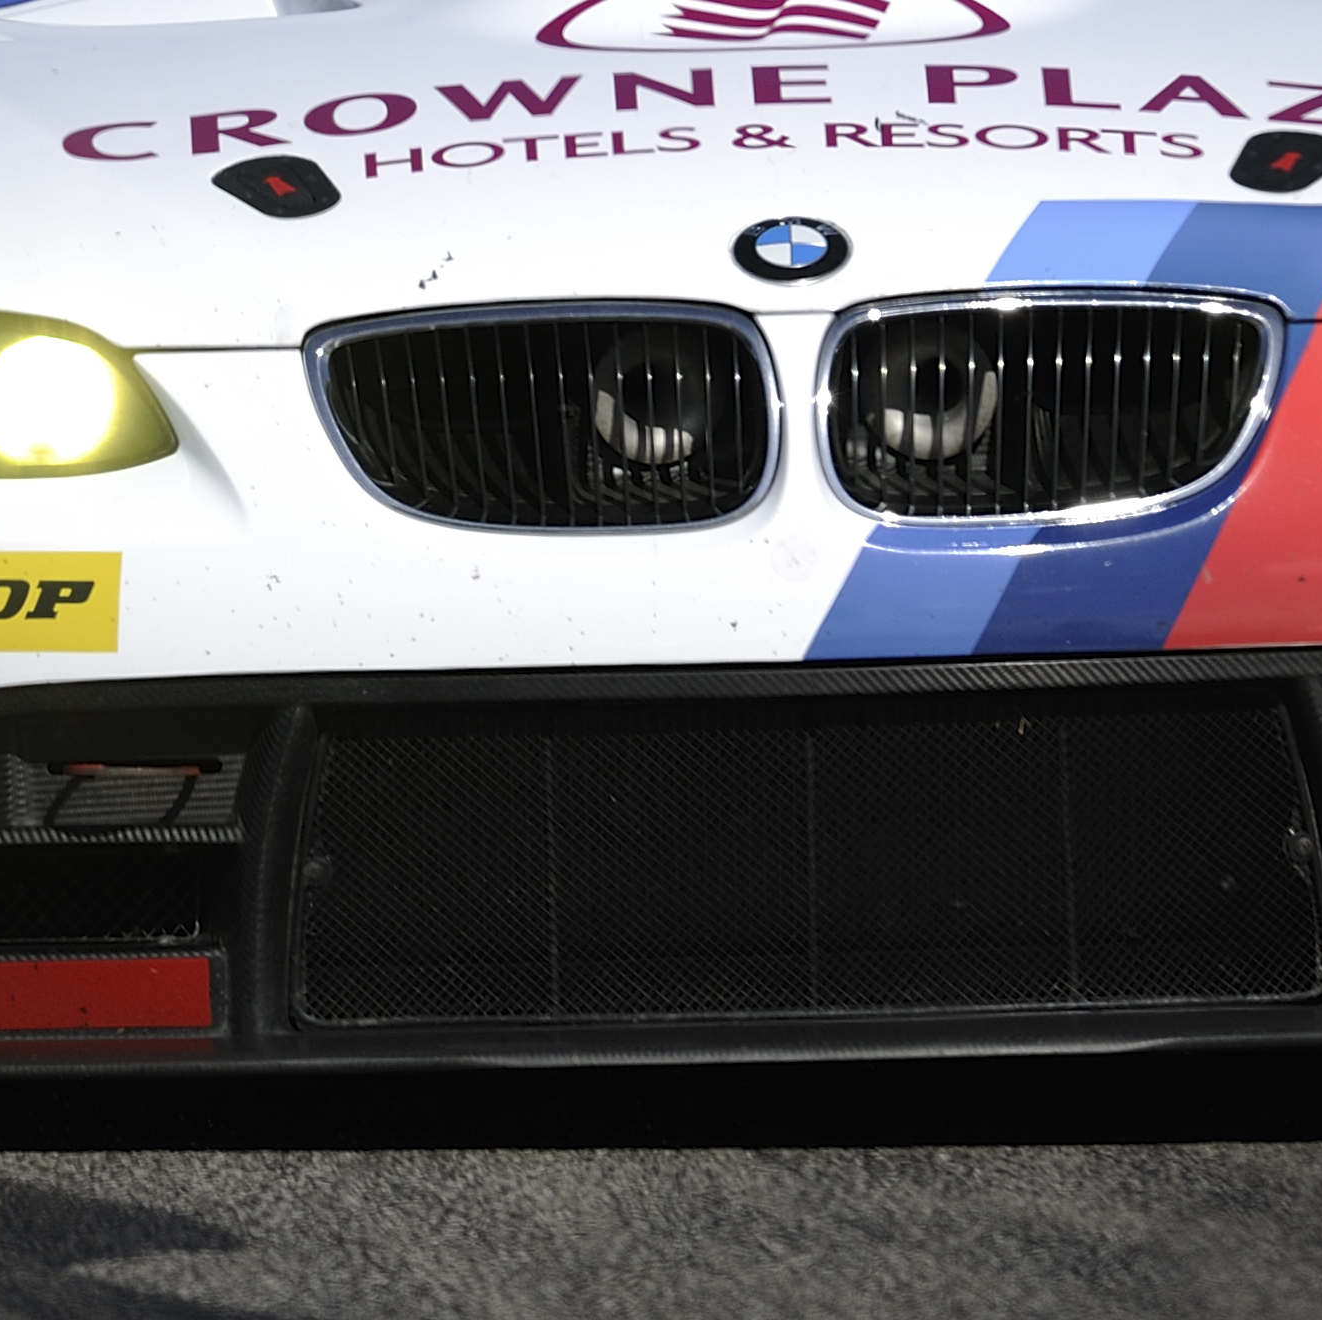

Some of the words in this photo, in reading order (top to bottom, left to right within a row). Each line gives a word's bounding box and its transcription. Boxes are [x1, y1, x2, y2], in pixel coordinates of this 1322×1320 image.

[62, 64, 832, 161] CROWNE
[364, 126, 701, 179] HOTELS
[731, 123, 797, 149] &
[825, 121, 1205, 159] RESORTS
